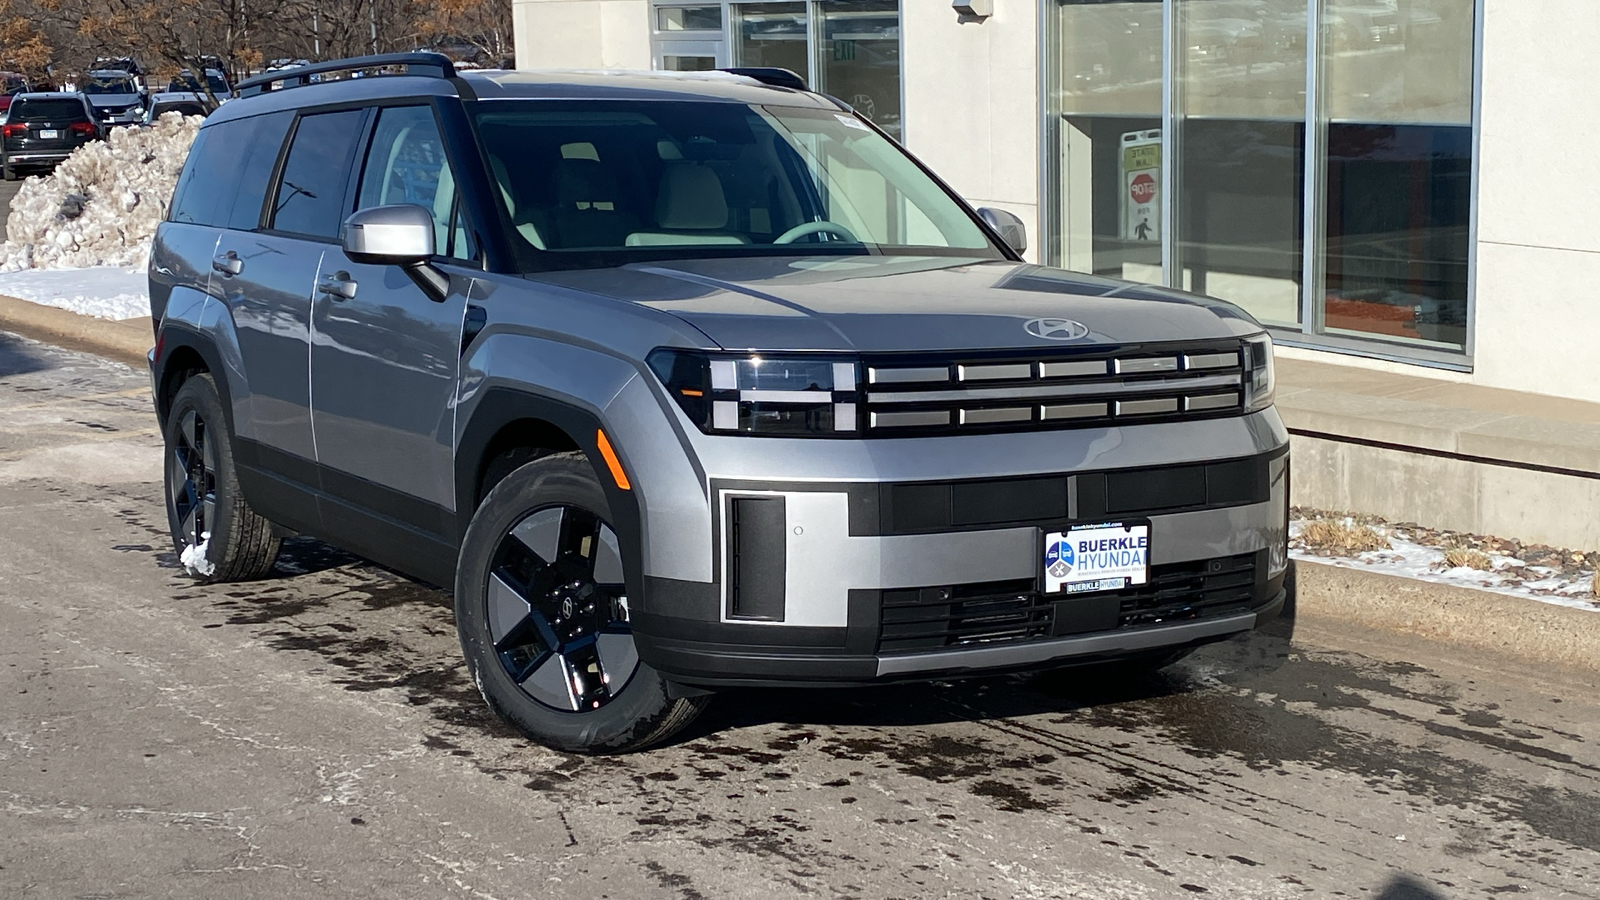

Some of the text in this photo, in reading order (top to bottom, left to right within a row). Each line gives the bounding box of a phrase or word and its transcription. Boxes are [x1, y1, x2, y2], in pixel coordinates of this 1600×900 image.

[833, 40, 856, 61] EXIT
[1079, 537, 1147, 553] BUERKLE
[1078, 550, 1146, 570] HYUNDAI
[1068, 579, 1123, 592] BUERKLE HYUNDAI
